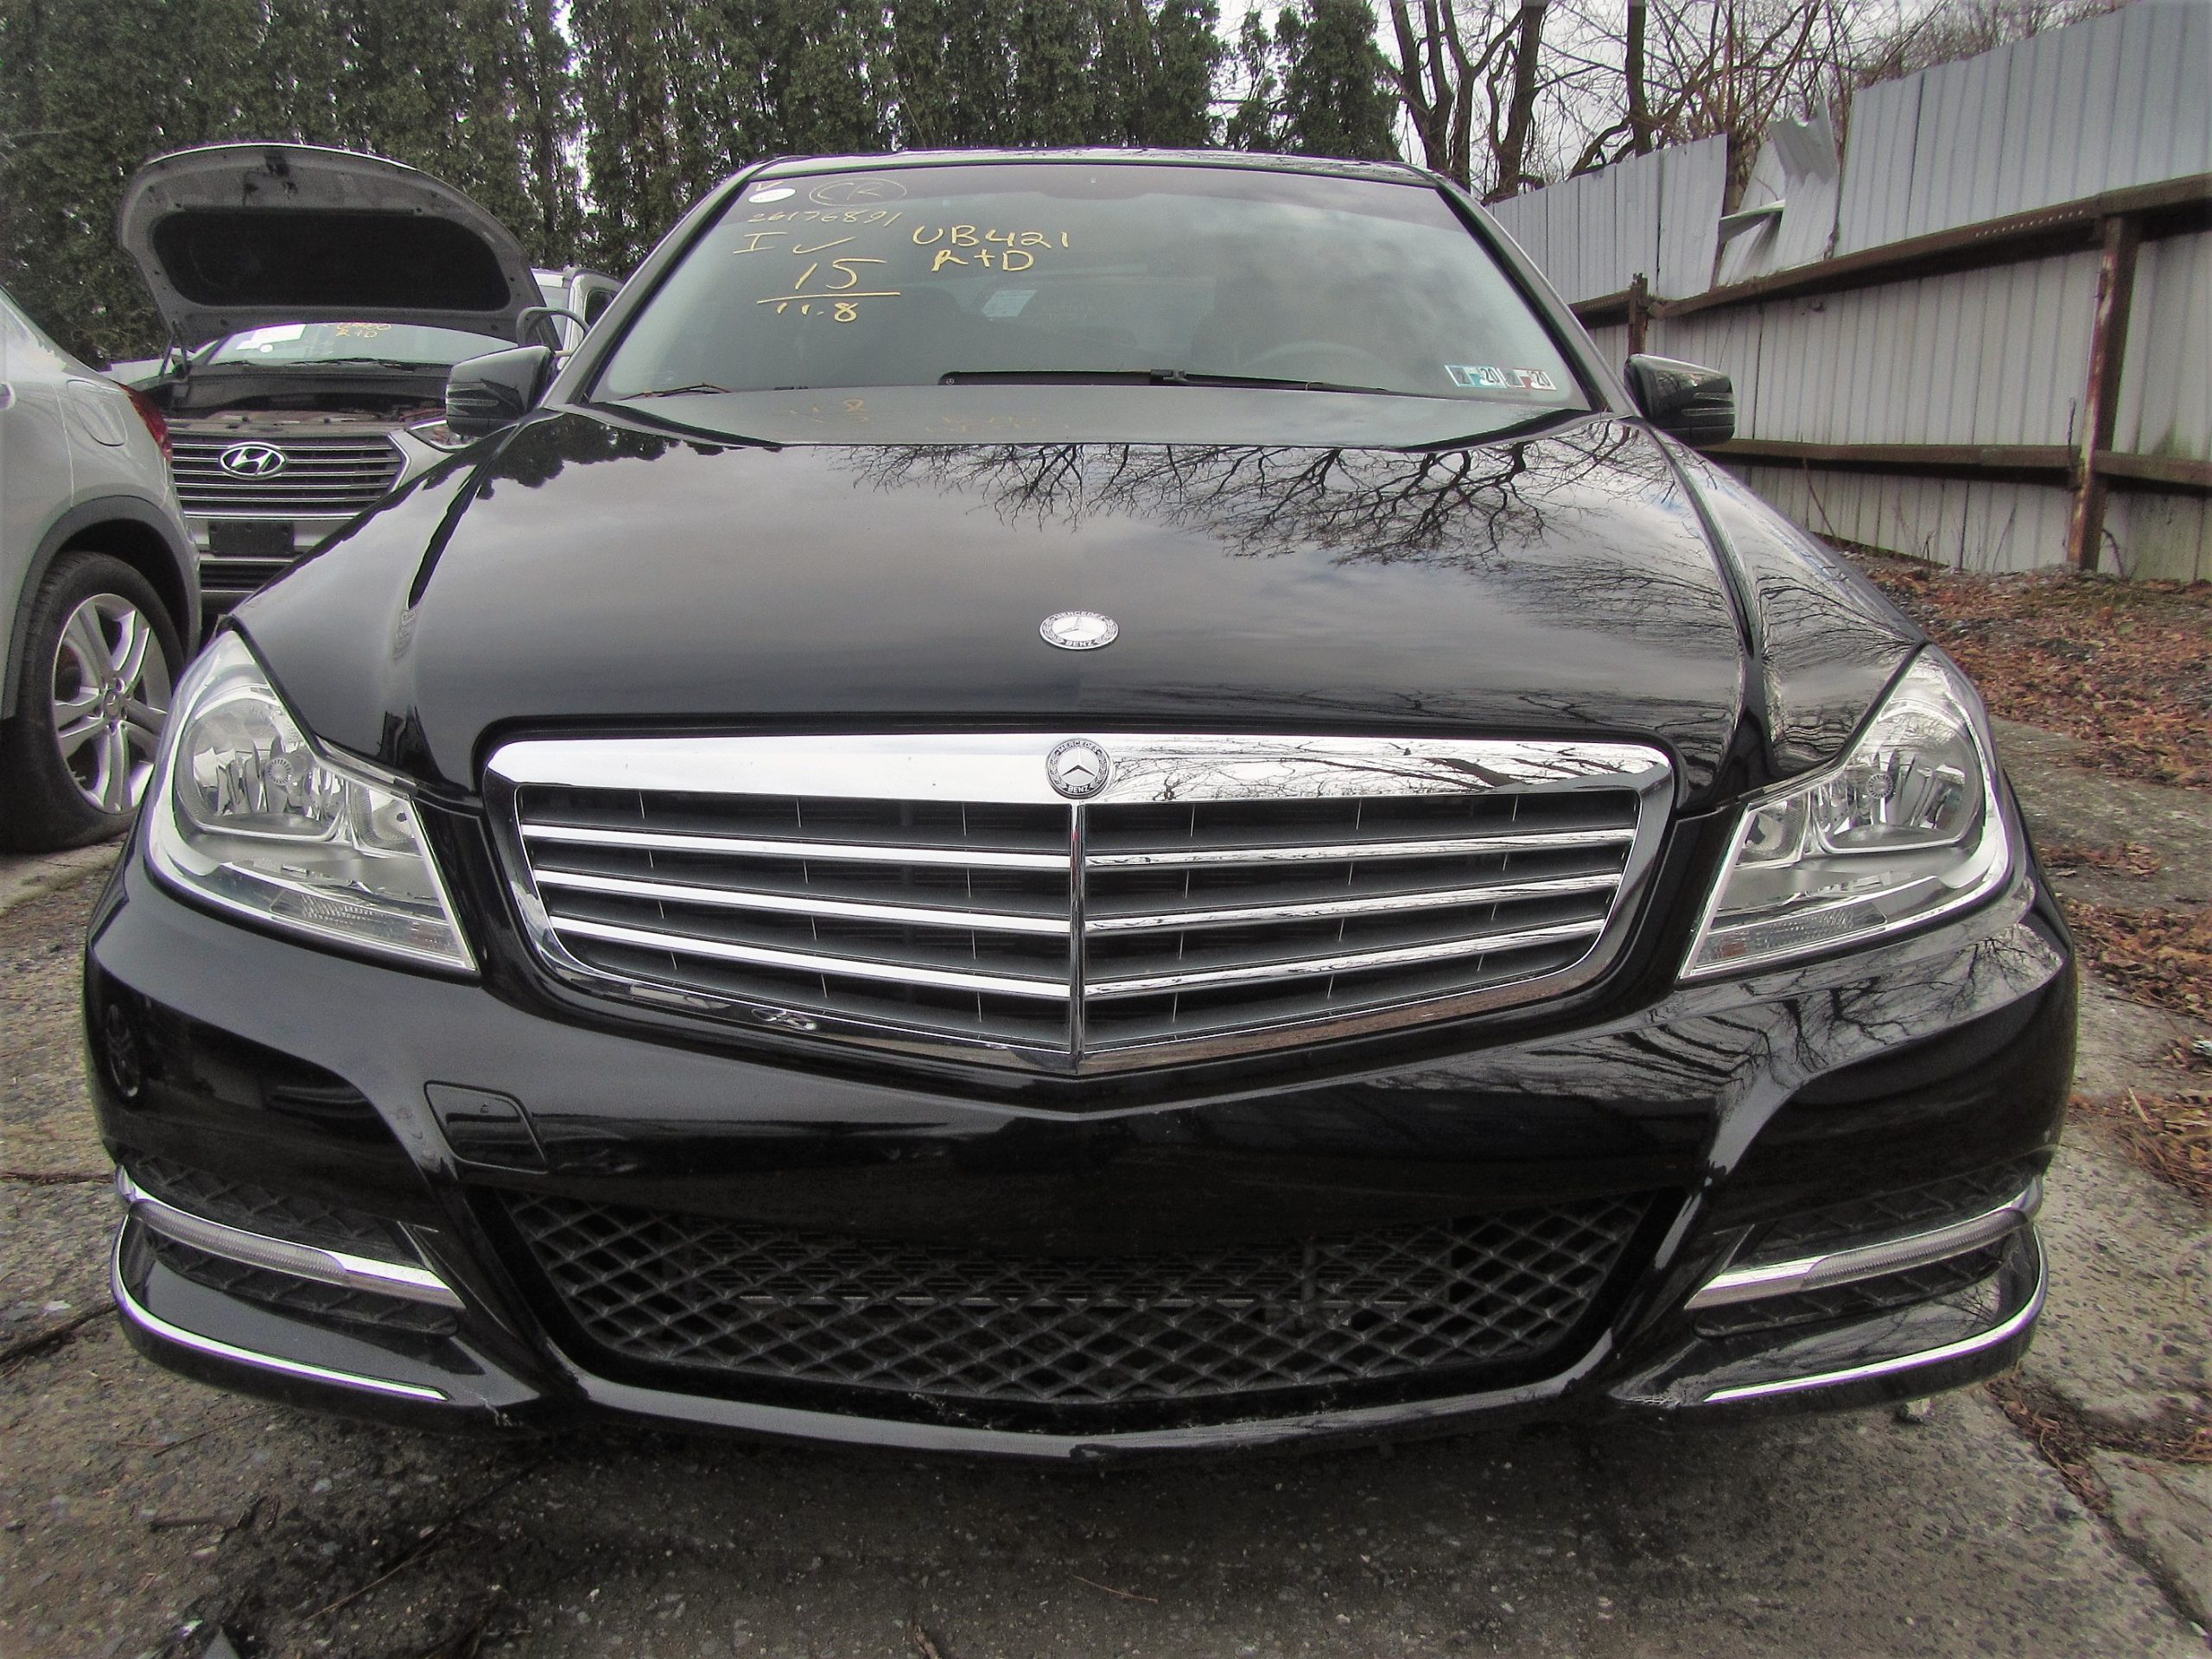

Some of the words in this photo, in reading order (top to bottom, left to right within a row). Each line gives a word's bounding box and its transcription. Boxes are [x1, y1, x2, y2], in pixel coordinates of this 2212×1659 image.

[912, 225, 1070, 250] UB421
[795, 257, 887, 290] 15
[1065, 639, 1096, 648] BENZ
[1067, 785, 1090, 793] BENZ
